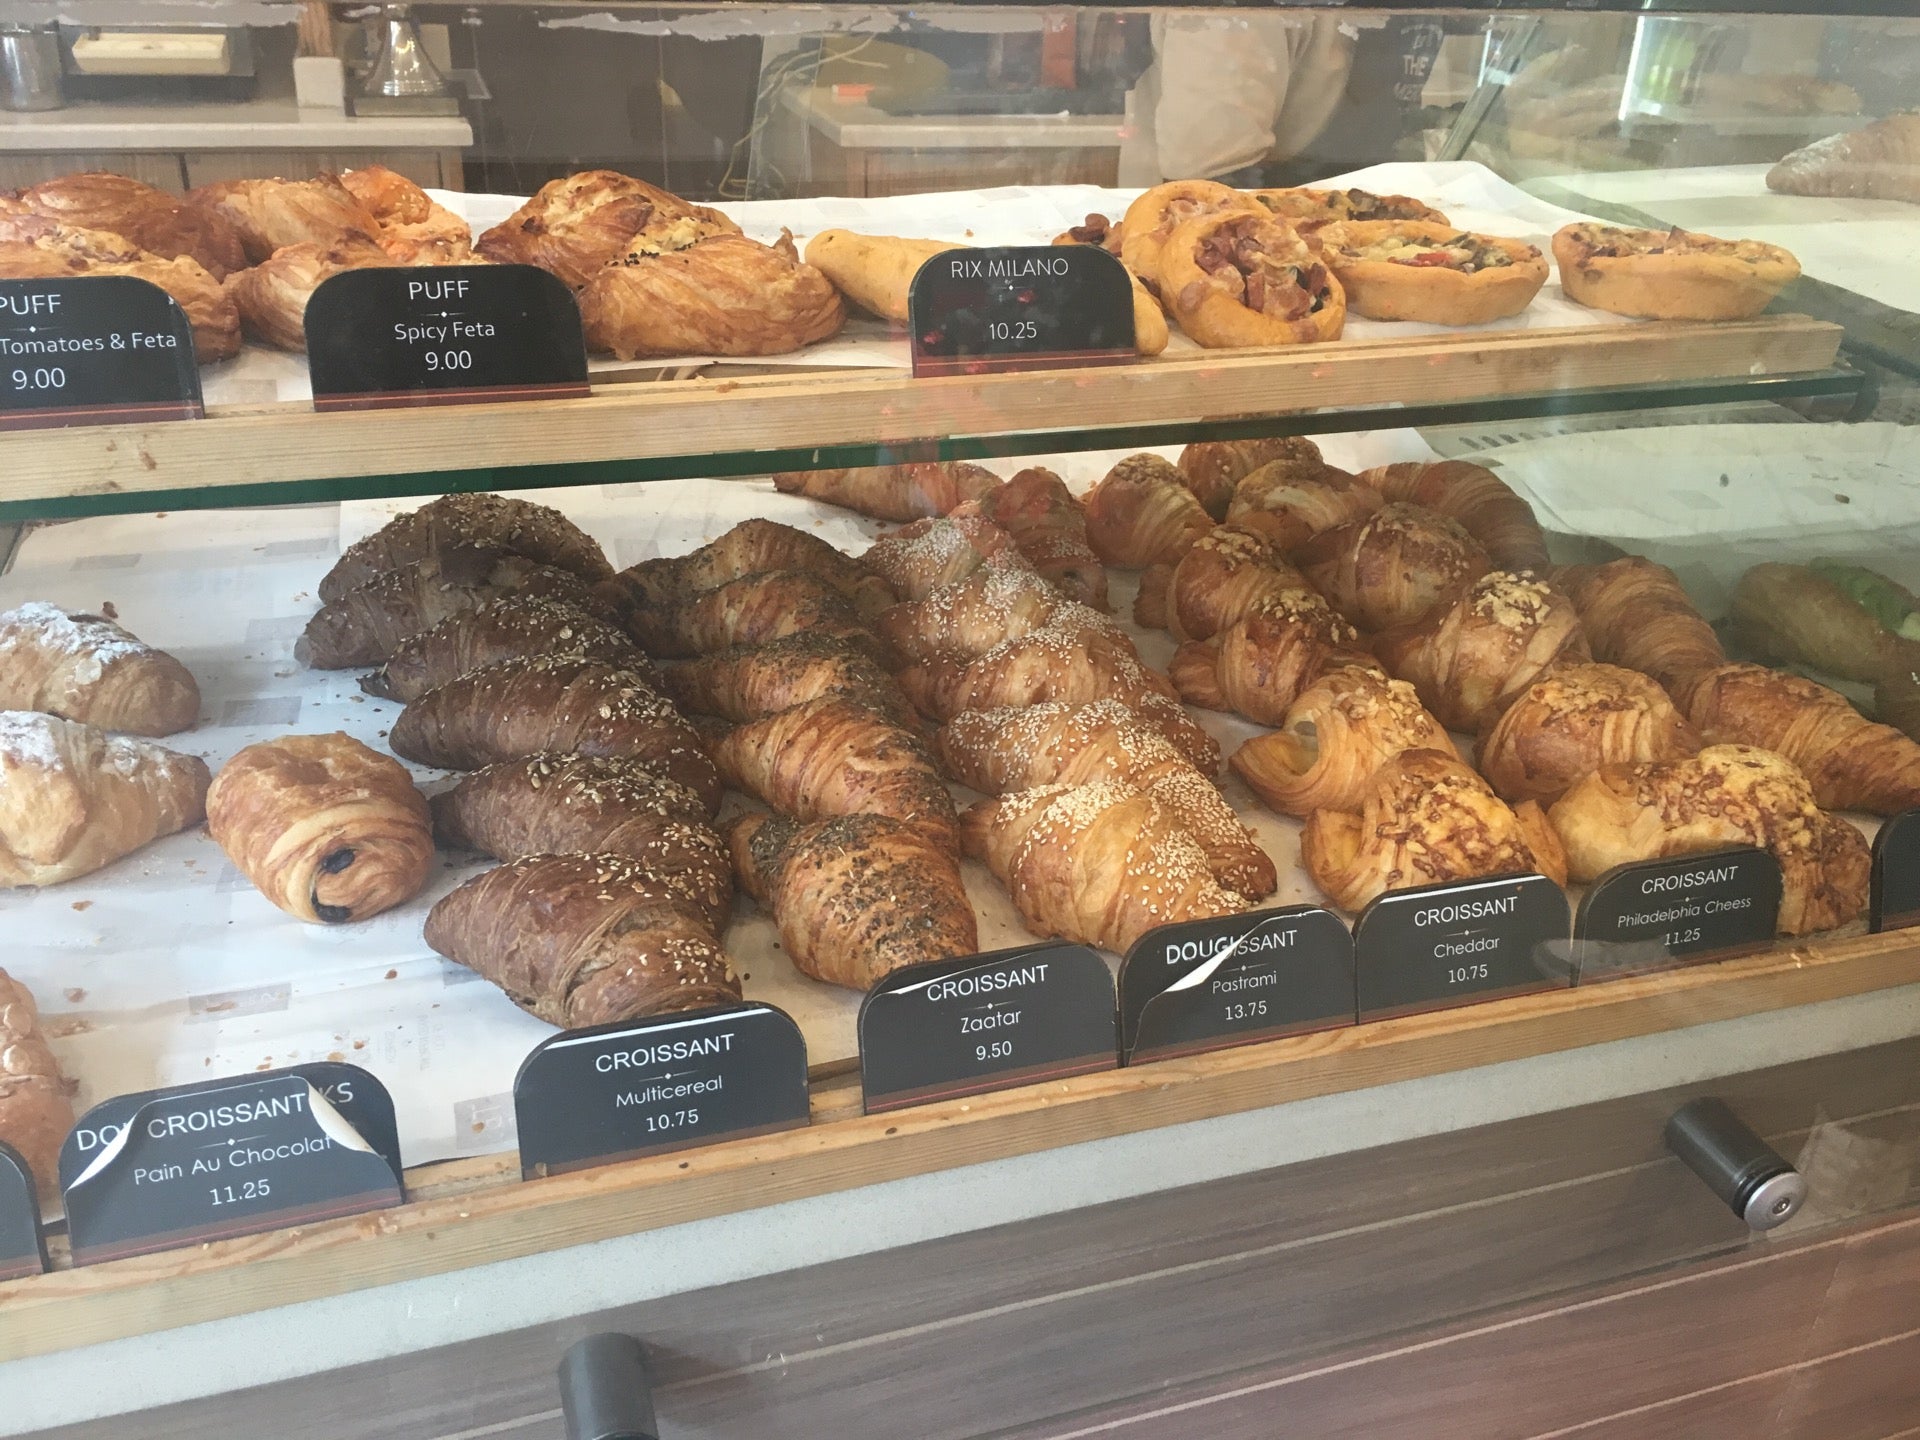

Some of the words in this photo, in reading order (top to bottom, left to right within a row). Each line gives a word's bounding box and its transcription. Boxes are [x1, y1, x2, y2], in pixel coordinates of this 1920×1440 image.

[951, 260, 983, 279] RIX
[988, 257, 1069, 277] MILANO
[408, 279, 470, 300] PUFF
[0, 337, 105, 355] Tomatoes
[110, 332, 126, 350] &
[131, 331, 177, 349] Feta
[394, 322, 447, 345] Spicy
[452, 321, 496, 338] Feta
[988, 321, 1038, 341] 10.25
[425, 350, 473, 371] 9.00
[11, 366, 67, 390] 9.00
[1640, 865, 1740, 895] CROISSANT
[1413, 895, 1519, 928] CROISSANT
[1617, 903, 1701, 929] Philadelphia
[1704, 896, 1752, 915] Cheess
[1433, 936, 1501, 959] Cheddar
[1663, 927, 1702, 947] 11.25
[1165, 934, 1234, 965] DOUG
[926, 963, 1049, 1002] CROISSANT
[1211, 970, 1278, 995] Pastrami
[1448, 963, 1489, 984] 10.75
[960, 1010, 1022, 1034] Zaatar
[1224, 1000, 1268, 1021] 13.75
[594, 1032, 735, 1073] CROISSANT
[975, 1040, 1013, 1061] 9.50
[615, 1074, 723, 1108] Multicereal
[147, 1092, 307, 1140] CROISSANT
[645, 1108, 700, 1133] 10.75
[134, 1163, 183, 1186] Pain
[190, 1156, 222, 1176] Au
[228, 1134, 334, 1168] Chocolat
[209, 1178, 271, 1206] 11.25
